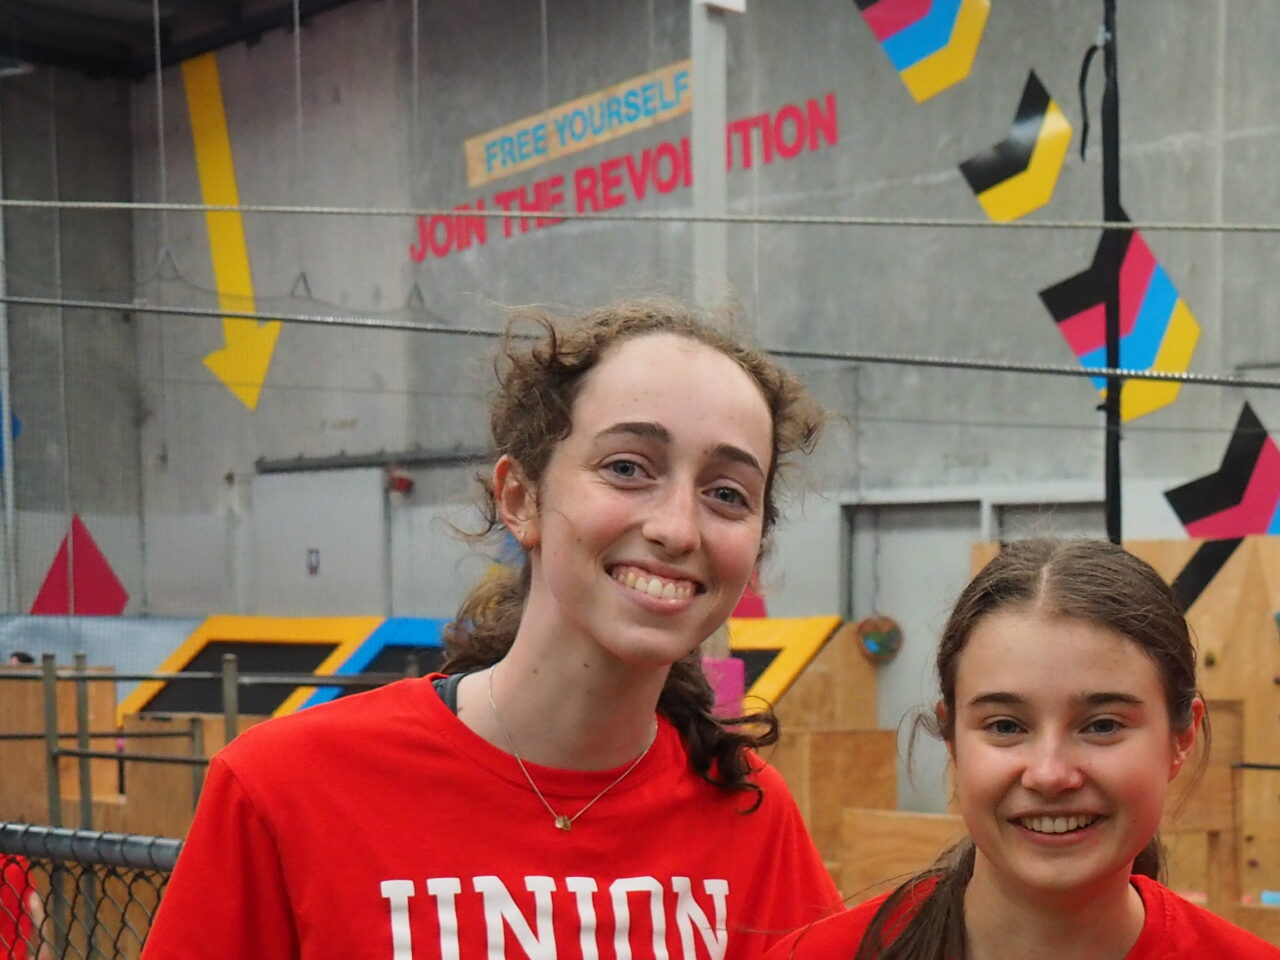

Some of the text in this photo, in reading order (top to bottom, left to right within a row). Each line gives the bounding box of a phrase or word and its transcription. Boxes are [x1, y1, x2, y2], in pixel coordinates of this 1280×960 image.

[486, 70, 690, 173] FREE YOURSELF
[410, 198, 487, 263] JOIN
[494, 175, 566, 238] THE
